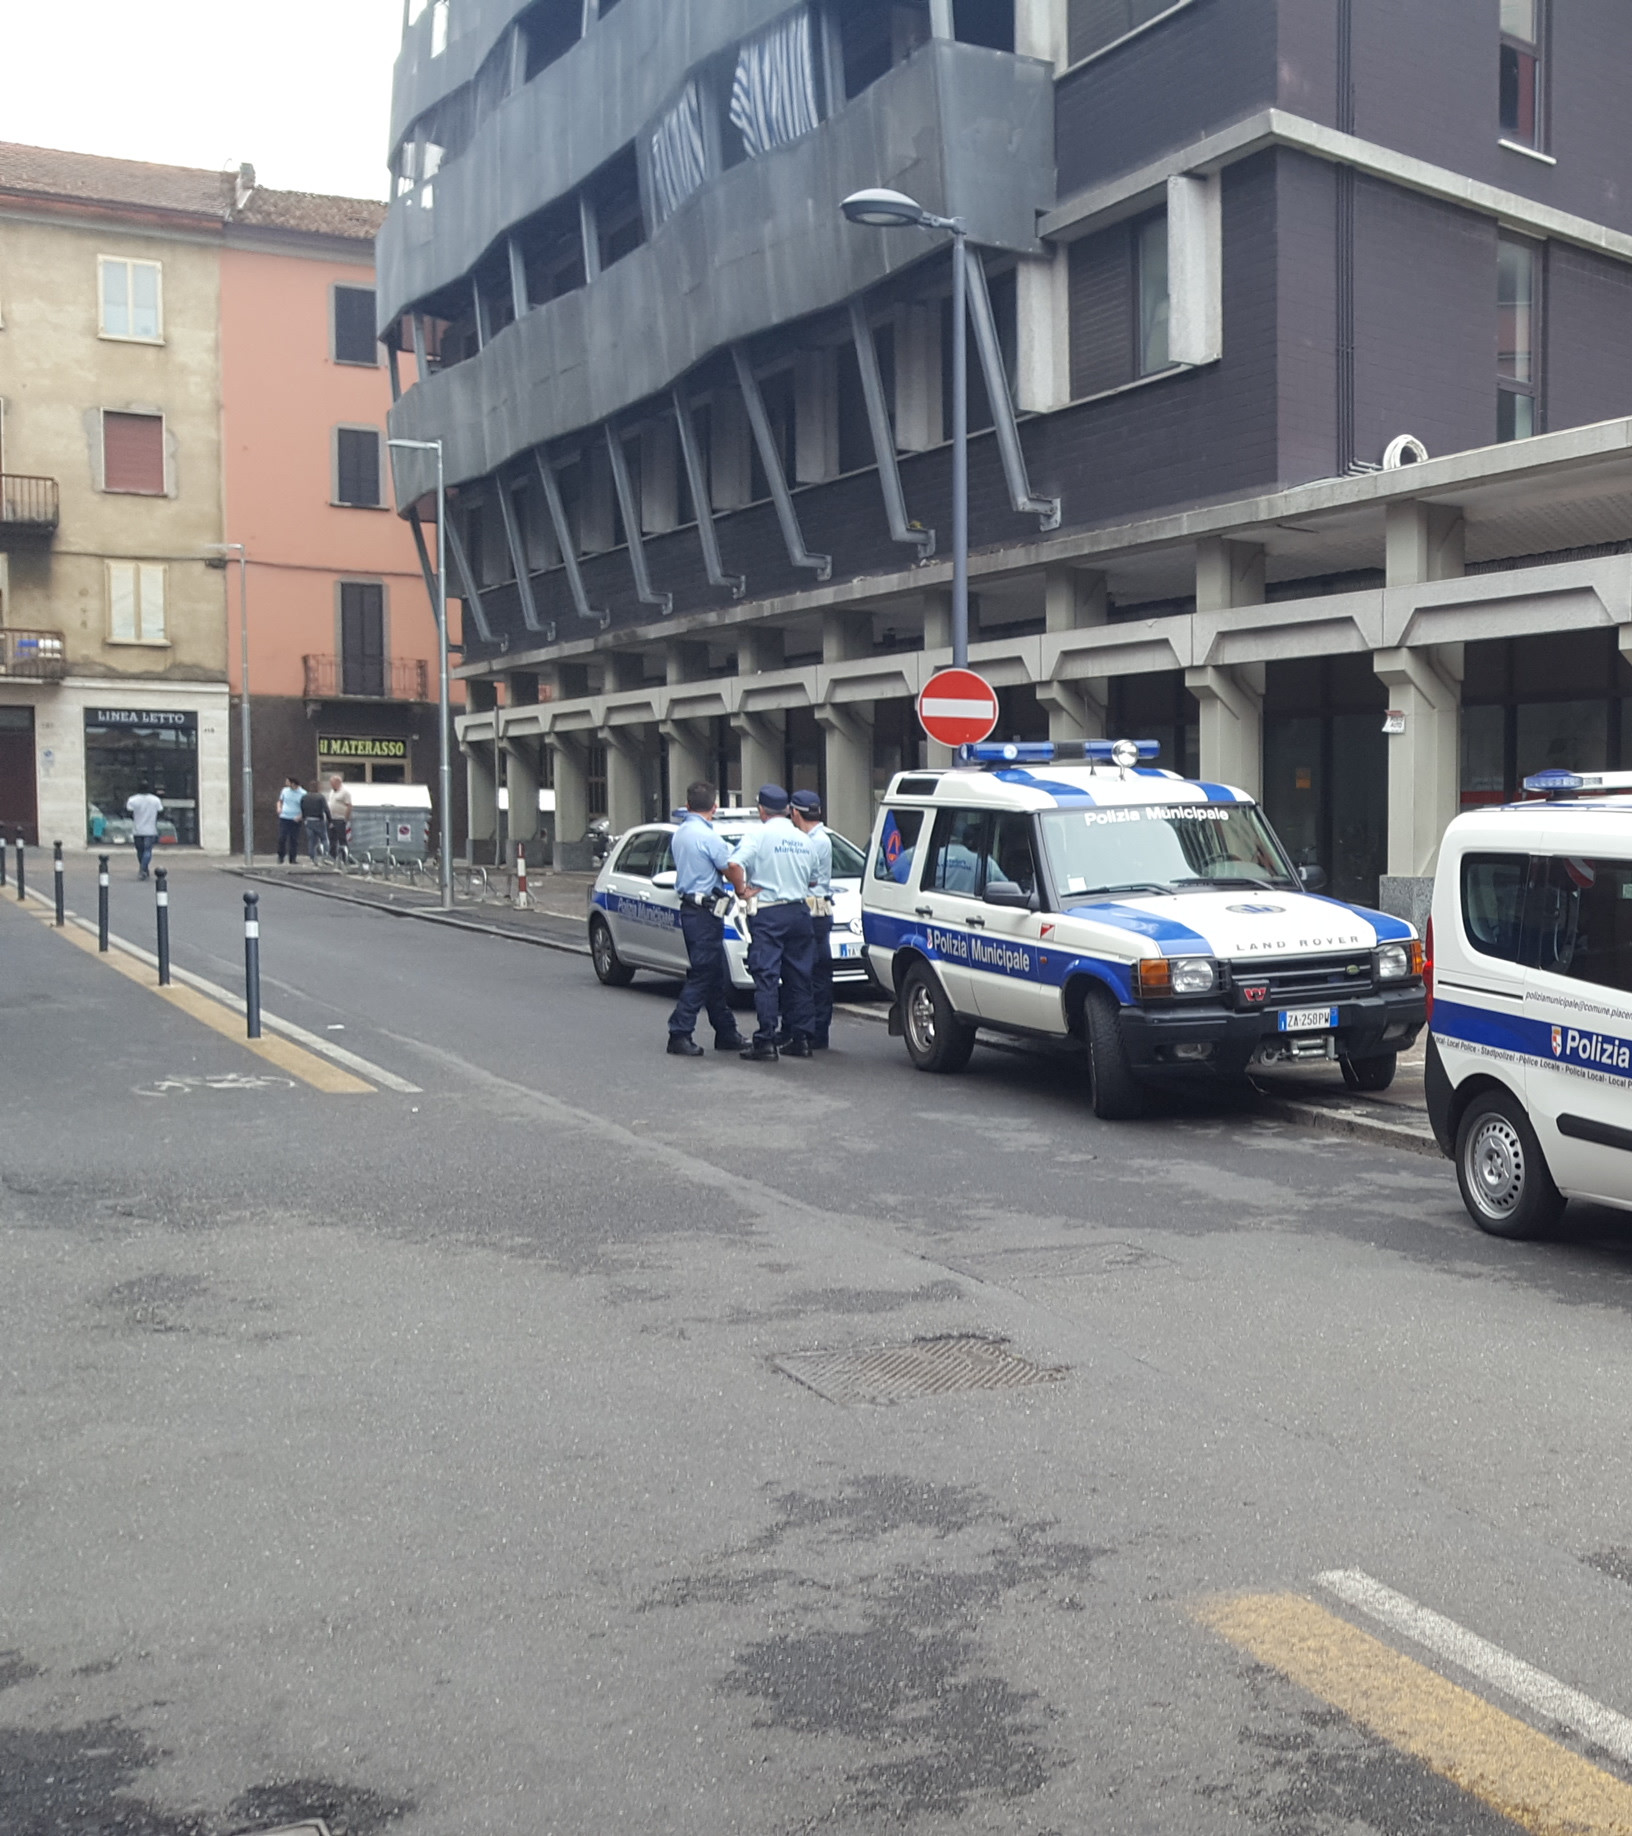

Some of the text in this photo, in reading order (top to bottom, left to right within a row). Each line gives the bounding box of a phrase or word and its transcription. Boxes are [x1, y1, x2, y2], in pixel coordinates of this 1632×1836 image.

[98, 711, 185, 725] LINEA LETTO
[331, 740, 405, 756] MATERASSO
[1084, 806, 1230, 827] Polizia Municipale
[933, 929, 1030, 974] Polizia Municipale
[1236, 935, 1359, 951] LAND ROVER
[1566, 1029, 1630, 1069] Polizia
[1460, 1041, 1477, 1053] Police
[1540, 1058, 1560, 1071] Locale
[1587, 1070, 1605, 1082] Local
[1608, 1077, 1627, 1088] Local
